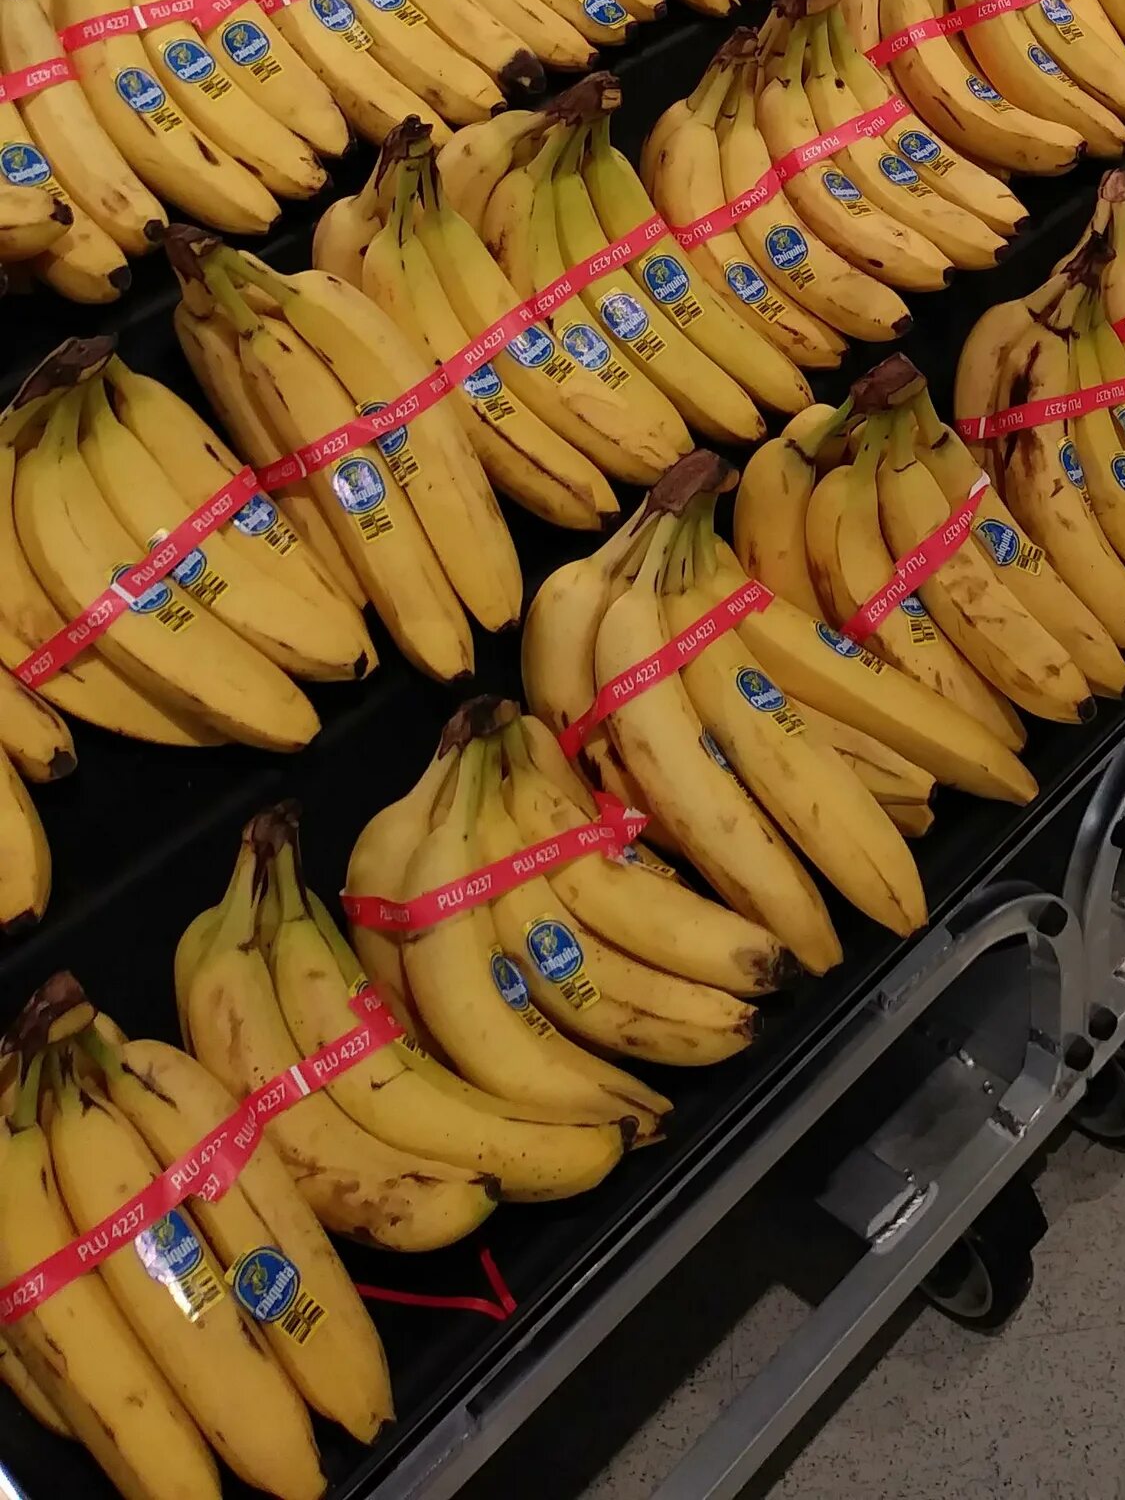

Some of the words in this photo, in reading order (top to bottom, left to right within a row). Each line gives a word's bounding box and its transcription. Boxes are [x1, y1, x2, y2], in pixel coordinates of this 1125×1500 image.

[151, 5, 170, 19] PLU
[171, 0, 194, 14] 4237
[978, 3, 997, 17] 4237
[84, 20, 104, 38] PLU
[105, 15, 129, 30] 4237
[908, 27, 925, 43] PLU
[233, 37, 267, 61] Chiquita
[891, 36, 909, 53] 4237
[26, 65, 50, 87] 4237
[802, 144, 822, 161] 4237
[820, 135, 840, 154] PLU
[750, 187, 768, 206] PLU
[731, 199, 751, 218] 4237
[693, 221, 712, 240] PLU
[589, 255, 611, 275] 4237
[611, 243, 632, 264] PLU
[773, 244, 807, 265] Chiquita
[550, 281, 572, 302] PLU
[654, 274, 688, 300] Chiquita
[534, 294, 555, 315] 4237
[464, 344, 484, 365] PLU
[484, 328, 505, 349] 4237
[1096, 391, 1112, 403] 4237
[1111, 386, 1125, 396] PLU
[371, 413, 394, 430] PLU
[394, 395, 420, 418] 4237
[1045, 402, 1067, 417] 4237
[1065, 398, 1082, 411] PLU
[323, 433, 349, 455] 4237
[192, 511, 214, 533] PLU
[211, 494, 233, 517] 4237
[942, 524, 961, 545] 4237
[131, 566, 155, 587] PLU
[152, 544, 178, 569] 4237
[905, 552, 927, 575] PLU
[727, 598, 746, 616] PLU
[743, 585, 762, 604] 4237
[883, 578, 906, 604] PLU
[67, 623, 91, 644] PLU
[87, 600, 114, 628] 4237
[867, 598, 888, 623] 4237
[677, 635, 698, 655] PLU
[696, 619, 717, 641] 4237
[30, 652, 54, 676] 4237
[612, 678, 635, 699] PLU
[636, 660, 661, 684] 4237
[578, 830, 600, 846] PLU
[513, 855, 536, 874] PLU
[535, 843, 561, 863] 4237
[437, 888, 463, 911] PLU
[466, 874, 492, 897] 4237
[539, 947, 580, 976] Chiquita
[313, 1049, 341, 1078] PLU
[340, 1030, 372, 1060] 4237
[256, 1084, 287, 1114] 4237
[234, 1120, 255, 1150] PLU
[170, 1160, 200, 1191] PLU
[77, 1230, 111, 1263] PLU
[111, 1203, 145, 1239] 4237
[12, 1272, 46, 1307] 4237
[255, 1262, 296, 1320] Chiquita
